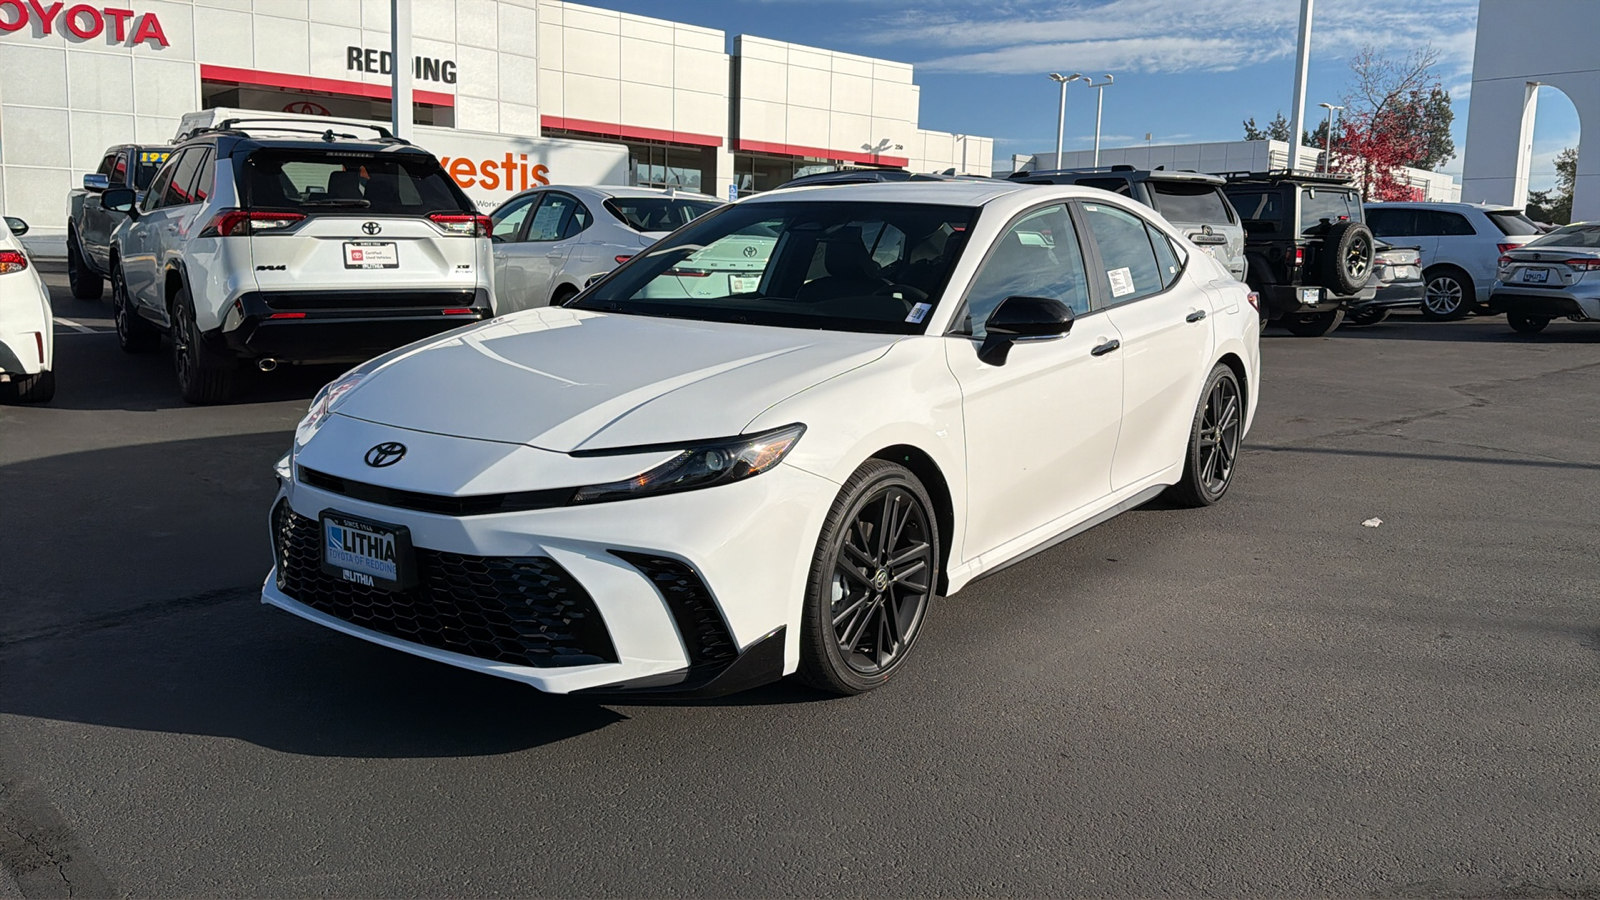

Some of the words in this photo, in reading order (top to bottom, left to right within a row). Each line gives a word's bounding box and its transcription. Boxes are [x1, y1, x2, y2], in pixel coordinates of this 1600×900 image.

[347, 46, 457, 84] REDING
[343, 519, 360, 530] SINCE
[342, 528, 397, 563] LITHIA
[328, 548, 354, 563] TOYOTA
[354, 555, 365, 565] OF
[349, 570, 375, 587] LITHIA
